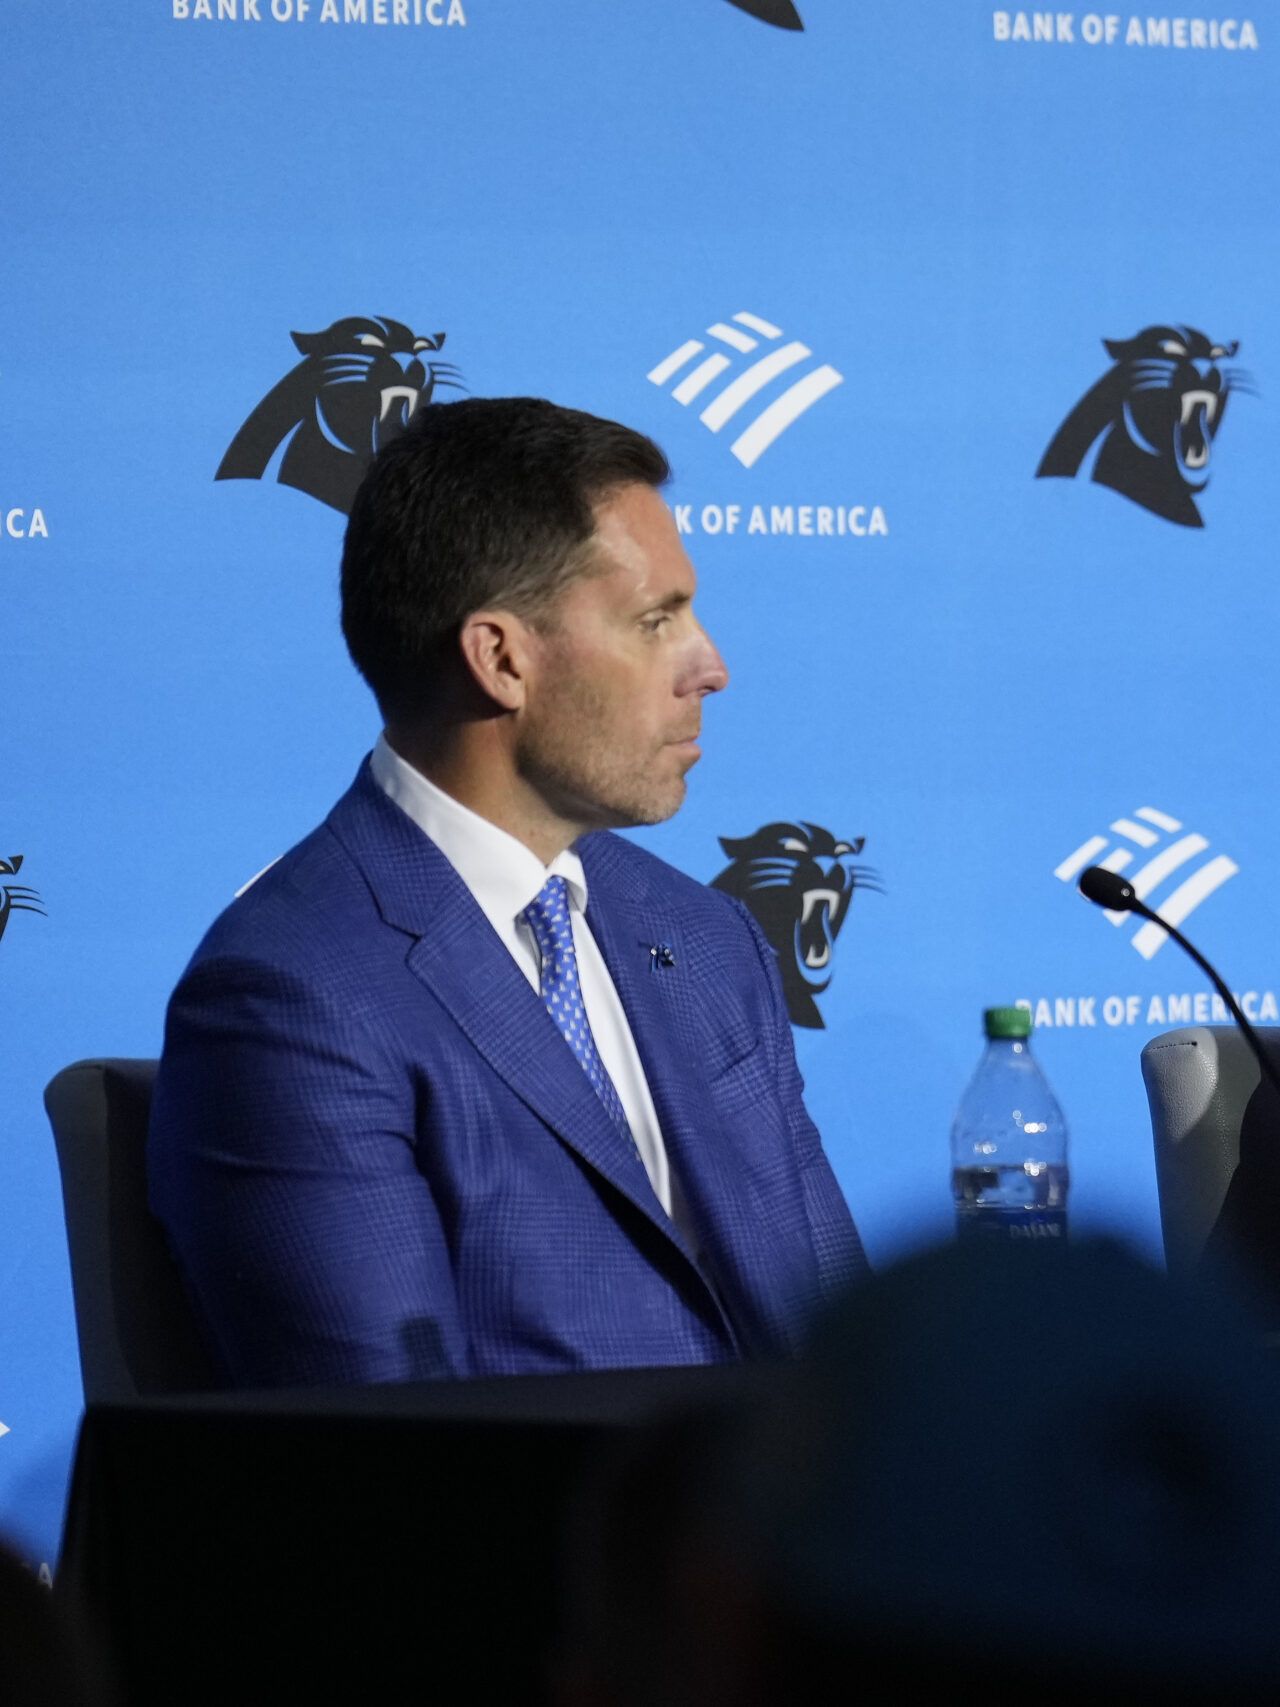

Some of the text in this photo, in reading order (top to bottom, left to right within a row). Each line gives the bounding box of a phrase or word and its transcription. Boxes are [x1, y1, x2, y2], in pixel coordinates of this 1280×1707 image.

[172, 0, 467, 27] BANK OF AMERICA
[992, 10, 1259, 50] BANK OF AMERICA
[700, 504, 741, 536] OF
[747, 504, 889, 537] AMERICA
[1102, 994, 1142, 1027] OF
